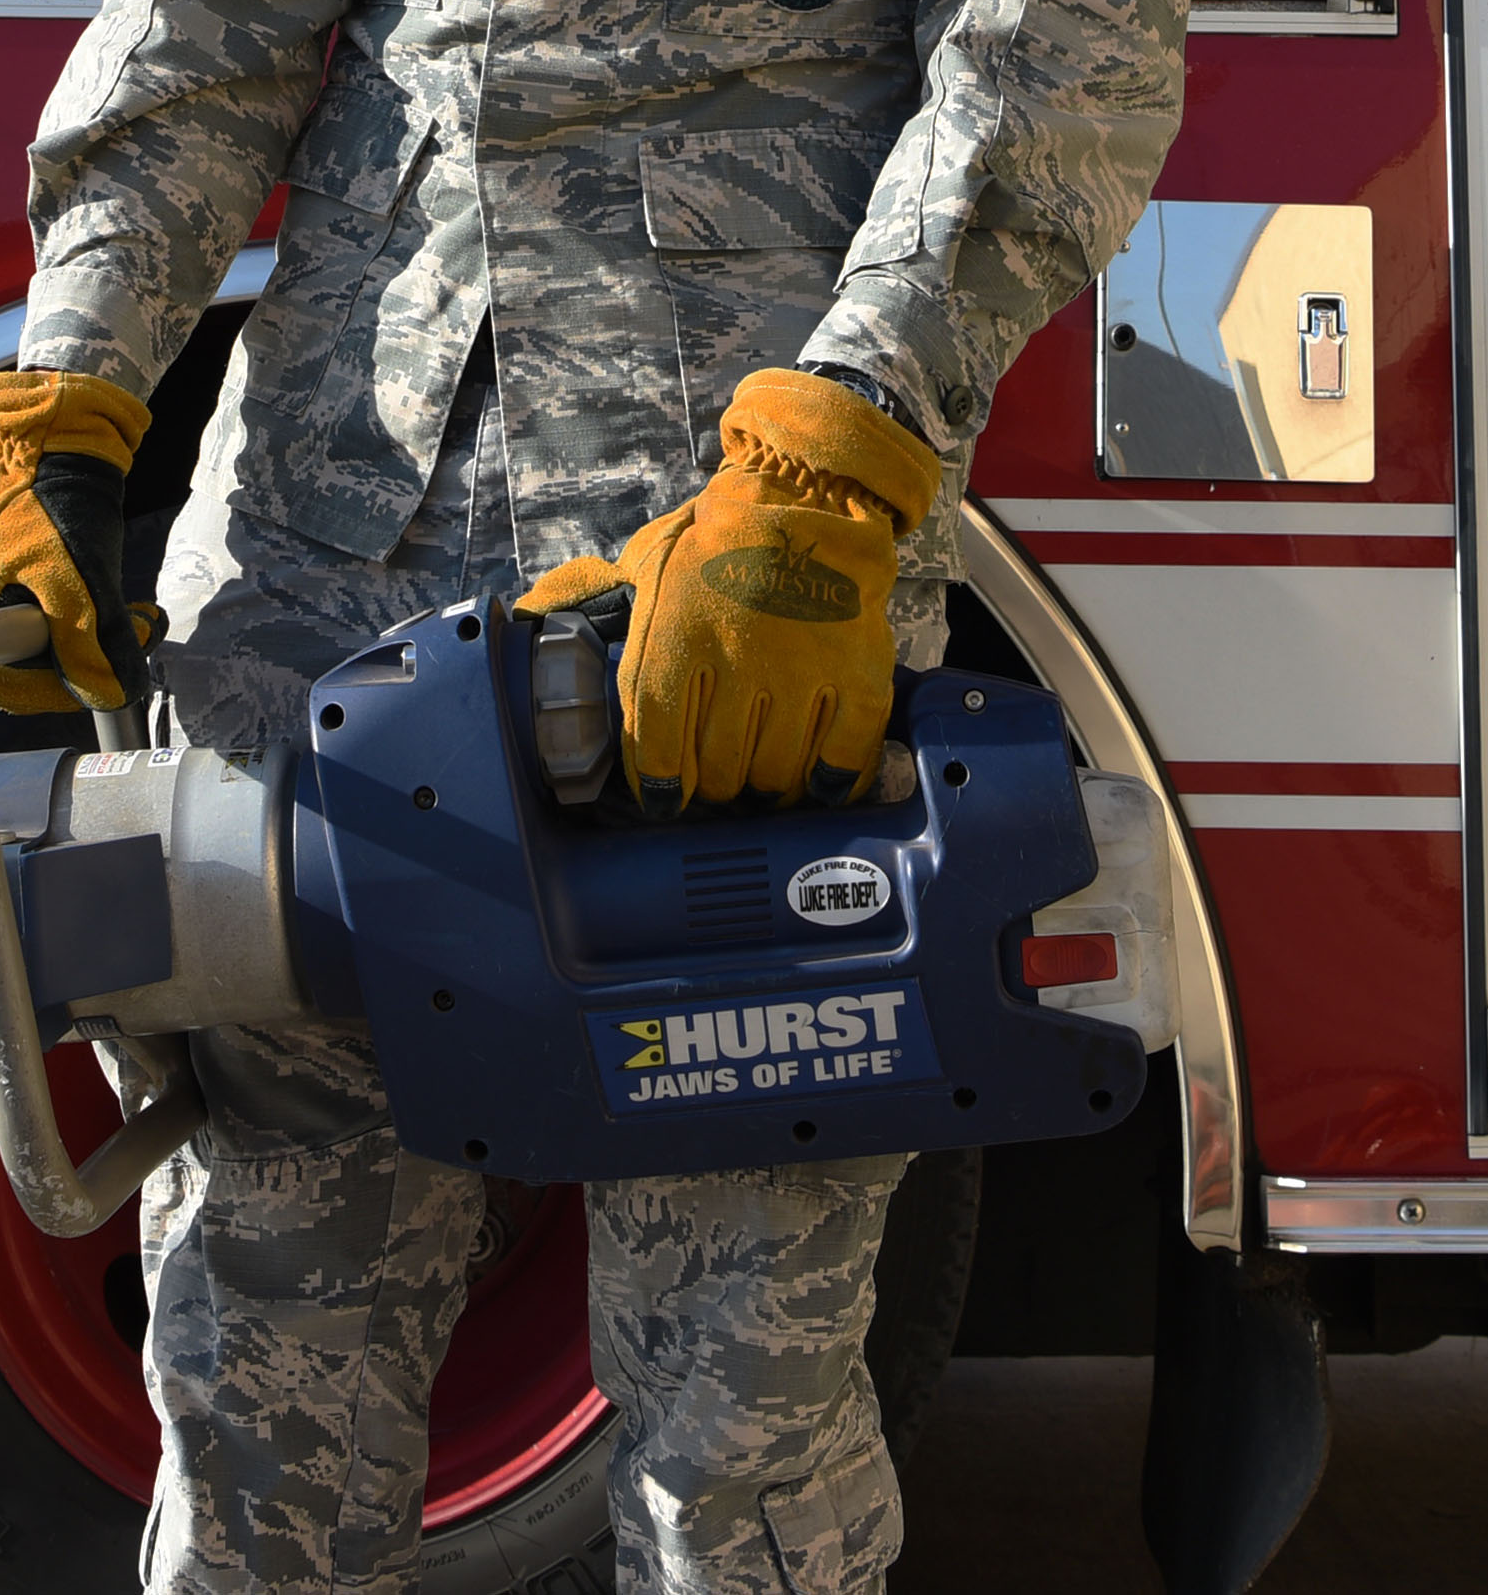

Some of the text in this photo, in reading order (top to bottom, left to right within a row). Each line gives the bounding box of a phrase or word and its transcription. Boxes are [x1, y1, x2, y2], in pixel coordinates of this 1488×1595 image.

[720, 563, 849, 605] MAJESTIC
[797, 864, 823, 883] LUKE
[824, 861, 848, 871] FIRE
[798, 880, 880, 913] LUKE FIRE DEPT.
[664, 990, 906, 1066] HURST
[629, 1067, 739, 1102] JAWS
[752, 1060, 799, 1089] OF
